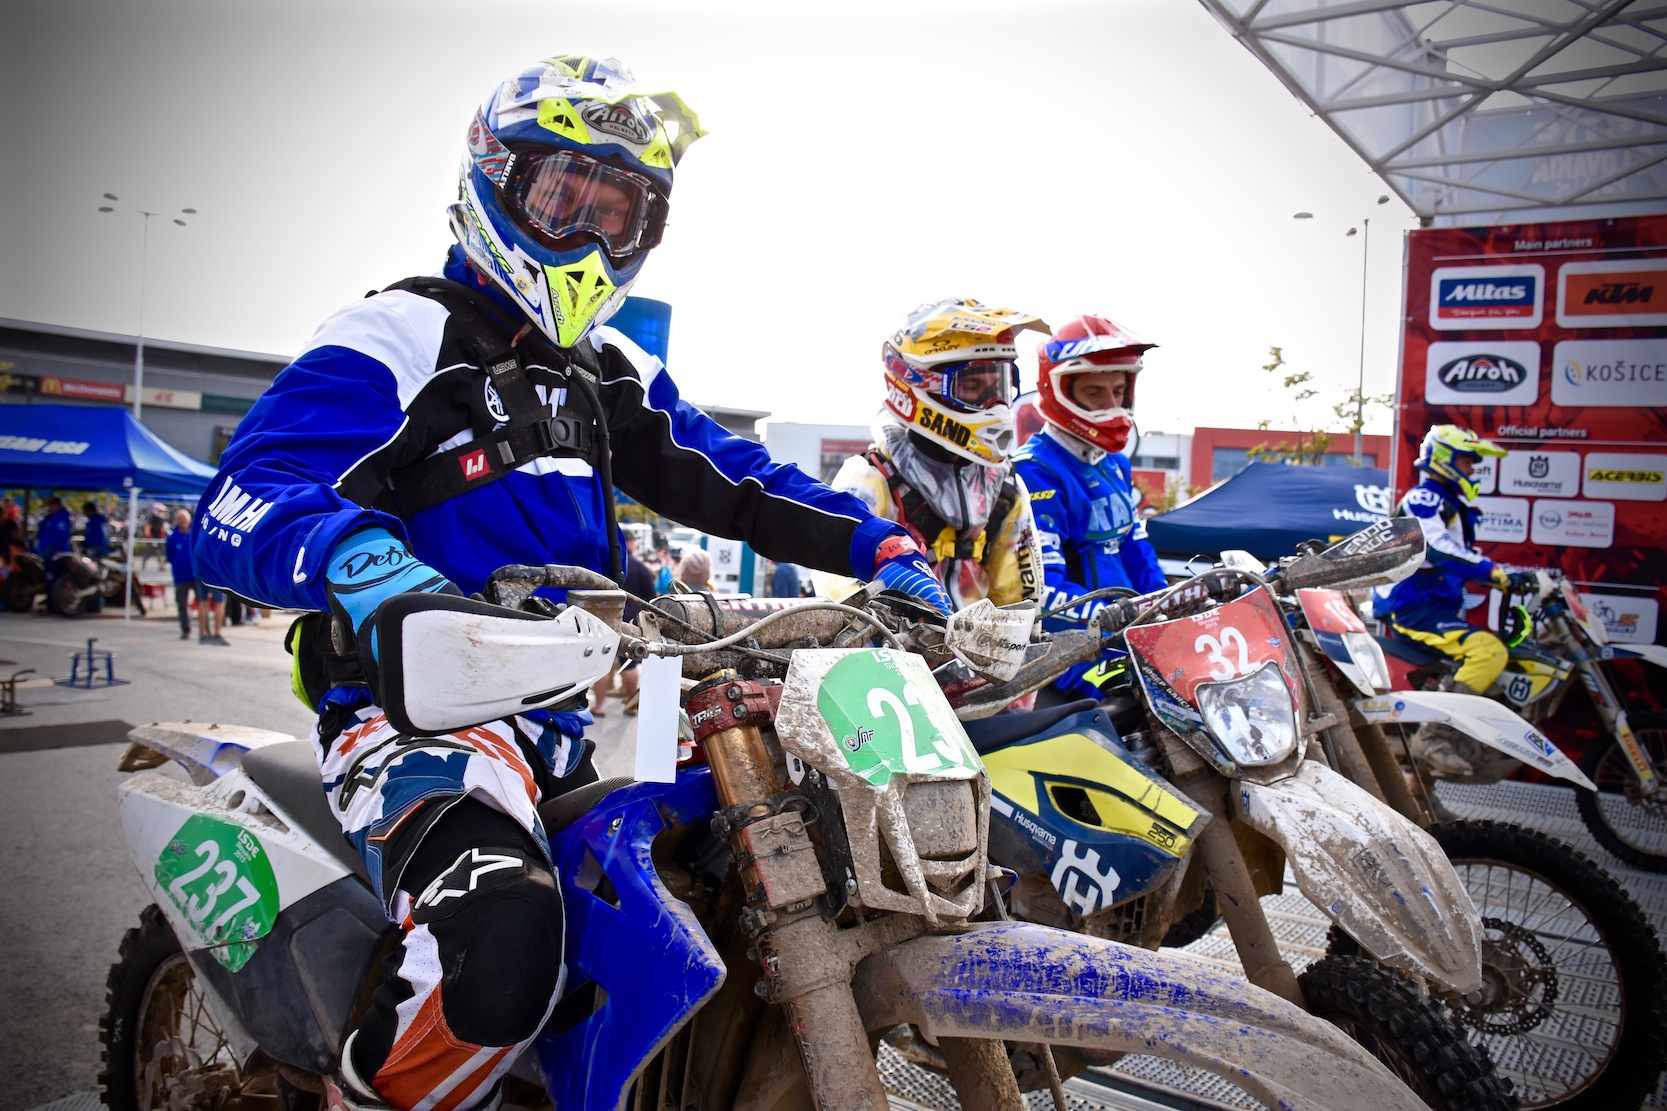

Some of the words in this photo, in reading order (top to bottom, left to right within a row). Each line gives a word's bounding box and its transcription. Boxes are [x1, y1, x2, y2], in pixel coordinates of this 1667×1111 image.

[588, 106, 646, 139] Airoh
[499, 153, 517, 190] OAKLEY
[1514, 239, 1542, 251] Main
[1544, 237, 1593, 251] partners
[1445, 283, 1527, 302] Mitas
[1583, 283, 1654, 305] KTM
[551, 287, 565, 325] Airoh
[924, 343, 960, 355] OAKLEY
[1443, 359, 1520, 383] Airoh
[1586, 360, 1666, 383] KOŠICE
[919, 407, 971, 448] SAND
[1498, 425, 1537, 437] Official
[1539, 427, 1587, 439] partners
[42, 440, 91, 455] USA
[1475, 466, 1492, 476] aft
[1589, 469, 1663, 484] ACERBIS
[1513, 479, 1563, 491] Husqvarna
[1480, 517, 1523, 528] PTIMA
[1205, 621, 1219, 630] 2015
[871, 649, 892, 663] IS
[1194, 626, 1262, 682] 32
[1142, 666, 1167, 688] JOSEP
[1014, 810, 1058, 846] Husqvarna
[1146, 824, 1175, 849] 250
[237, 829, 260, 858] ISDE
[168, 839, 261, 940] 237
